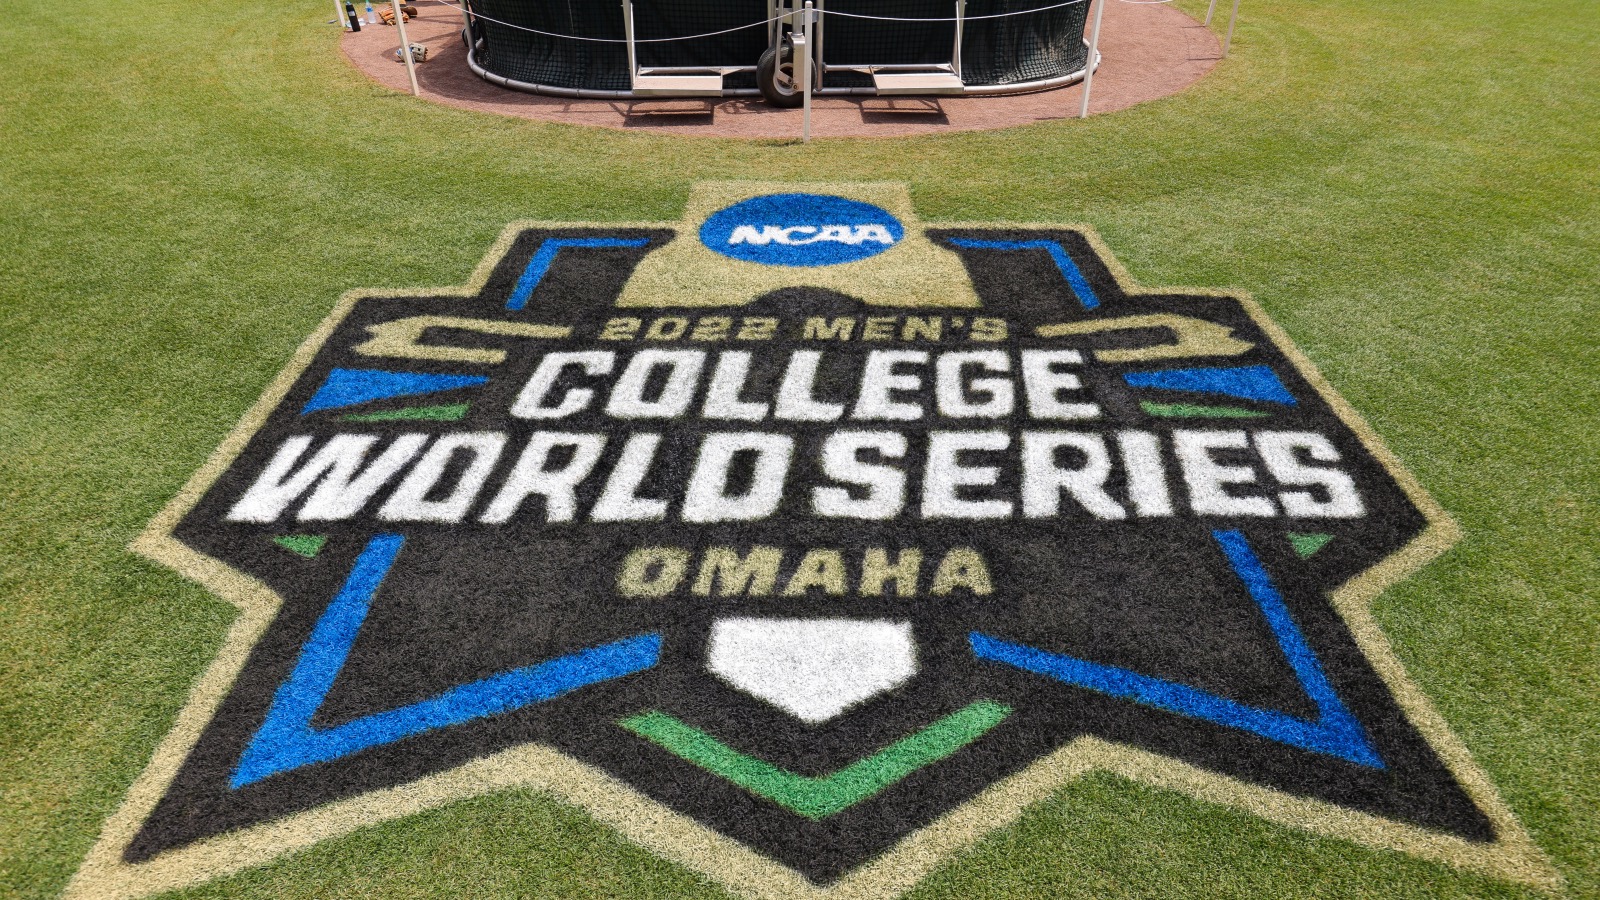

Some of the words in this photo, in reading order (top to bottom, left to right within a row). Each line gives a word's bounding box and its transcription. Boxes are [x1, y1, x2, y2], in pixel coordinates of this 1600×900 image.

[727, 223, 894, 246] NCAA
[599, 316, 778, 341] 2022
[803, 315, 1010, 341] MEN'S
[510, 349, 1101, 421] COLLEGE
[226, 431, 795, 524] WORLD
[811, 429, 1366, 520] SERIES
[615, 546, 994, 598] OMAHA
